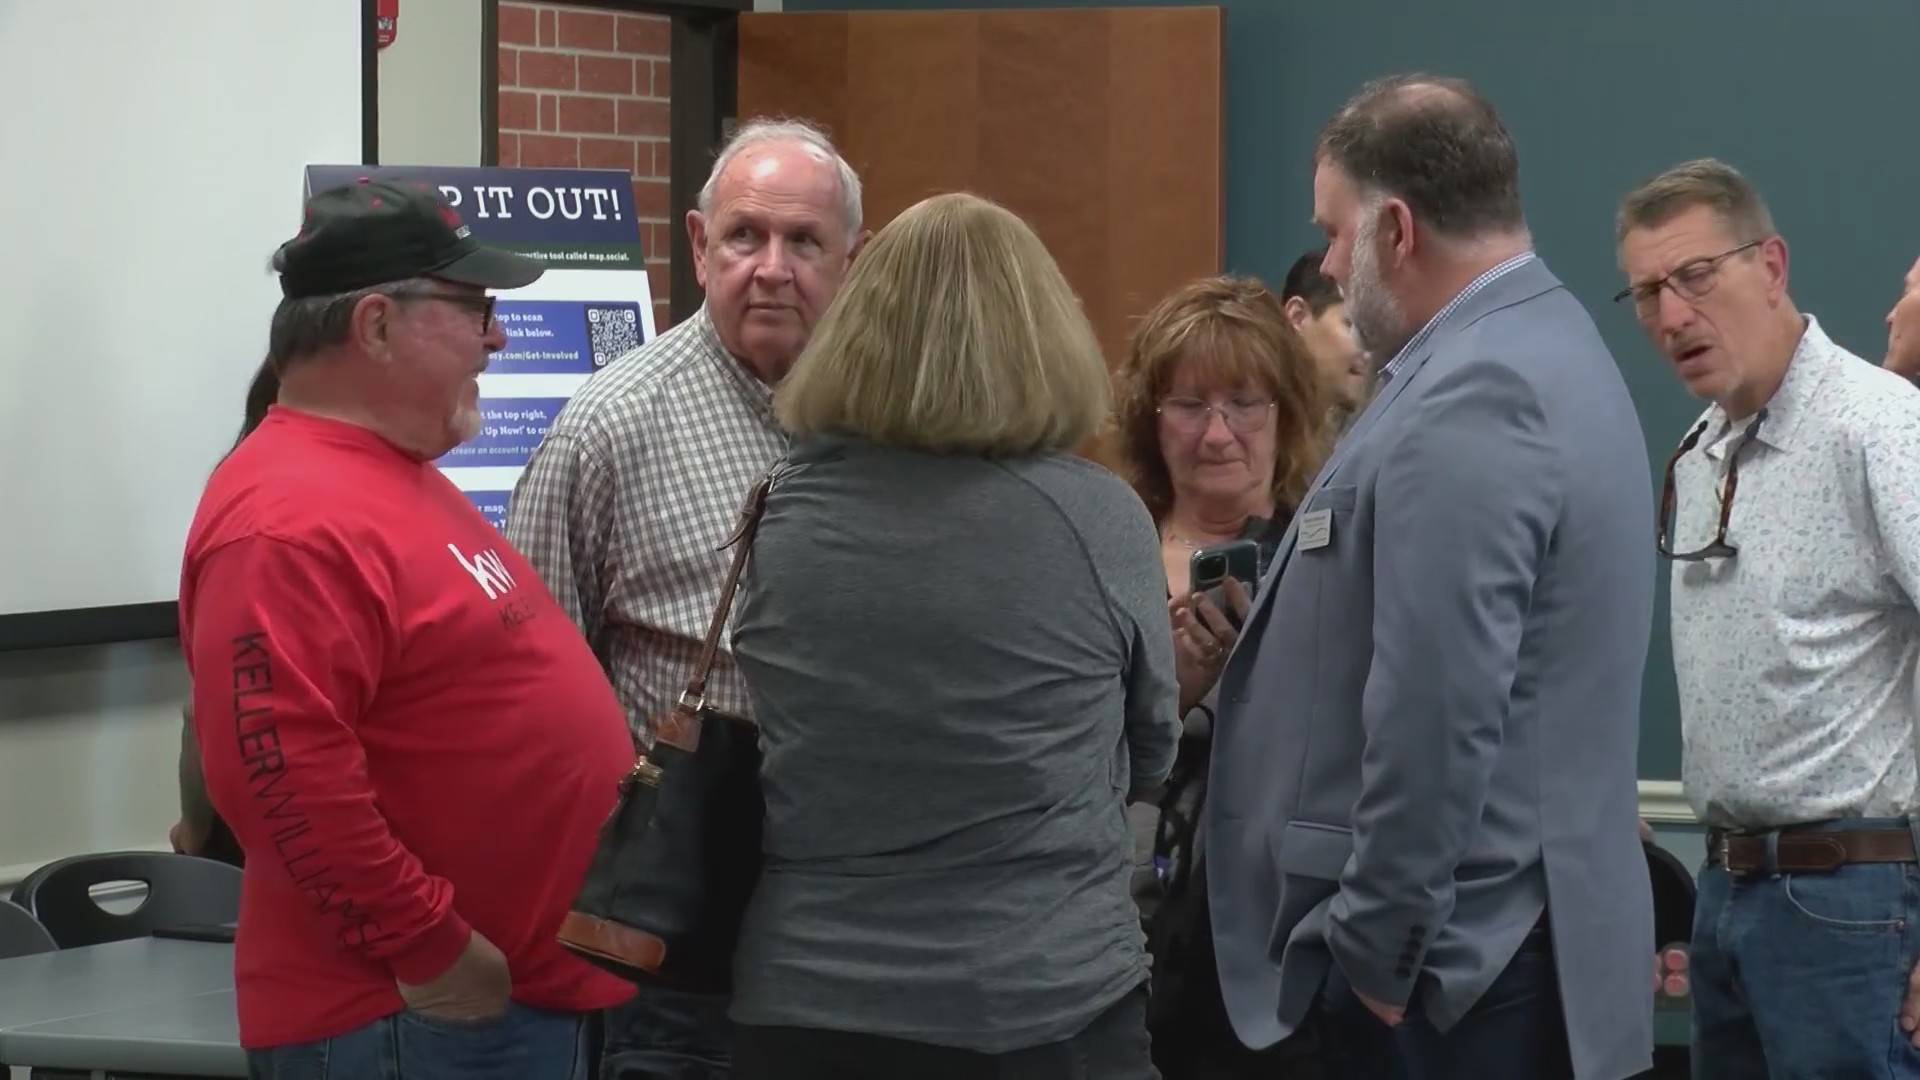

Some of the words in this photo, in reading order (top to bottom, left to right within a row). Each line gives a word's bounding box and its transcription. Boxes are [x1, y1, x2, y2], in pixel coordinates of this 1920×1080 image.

[473, 186, 514, 218] IT
[527, 187, 621, 220] OUT!
[549, 251, 564, 261] tool
[565, 251, 588, 261] called
[588, 252, 630, 262] map.social.
[511, 313, 521, 321] to
[506, 327, 524, 337] link
[525, 327, 555, 337] below.
[487, 410, 502, 420] the
[504, 410, 520, 421] top
[521, 409, 548, 421] right,
[485, 426, 498, 437] Up
[526, 426, 537, 435] to
[477, 447, 488, 455] an
[489, 446, 519, 455] account
[520, 446, 529, 454] to
[484, 505, 507, 514] map.
